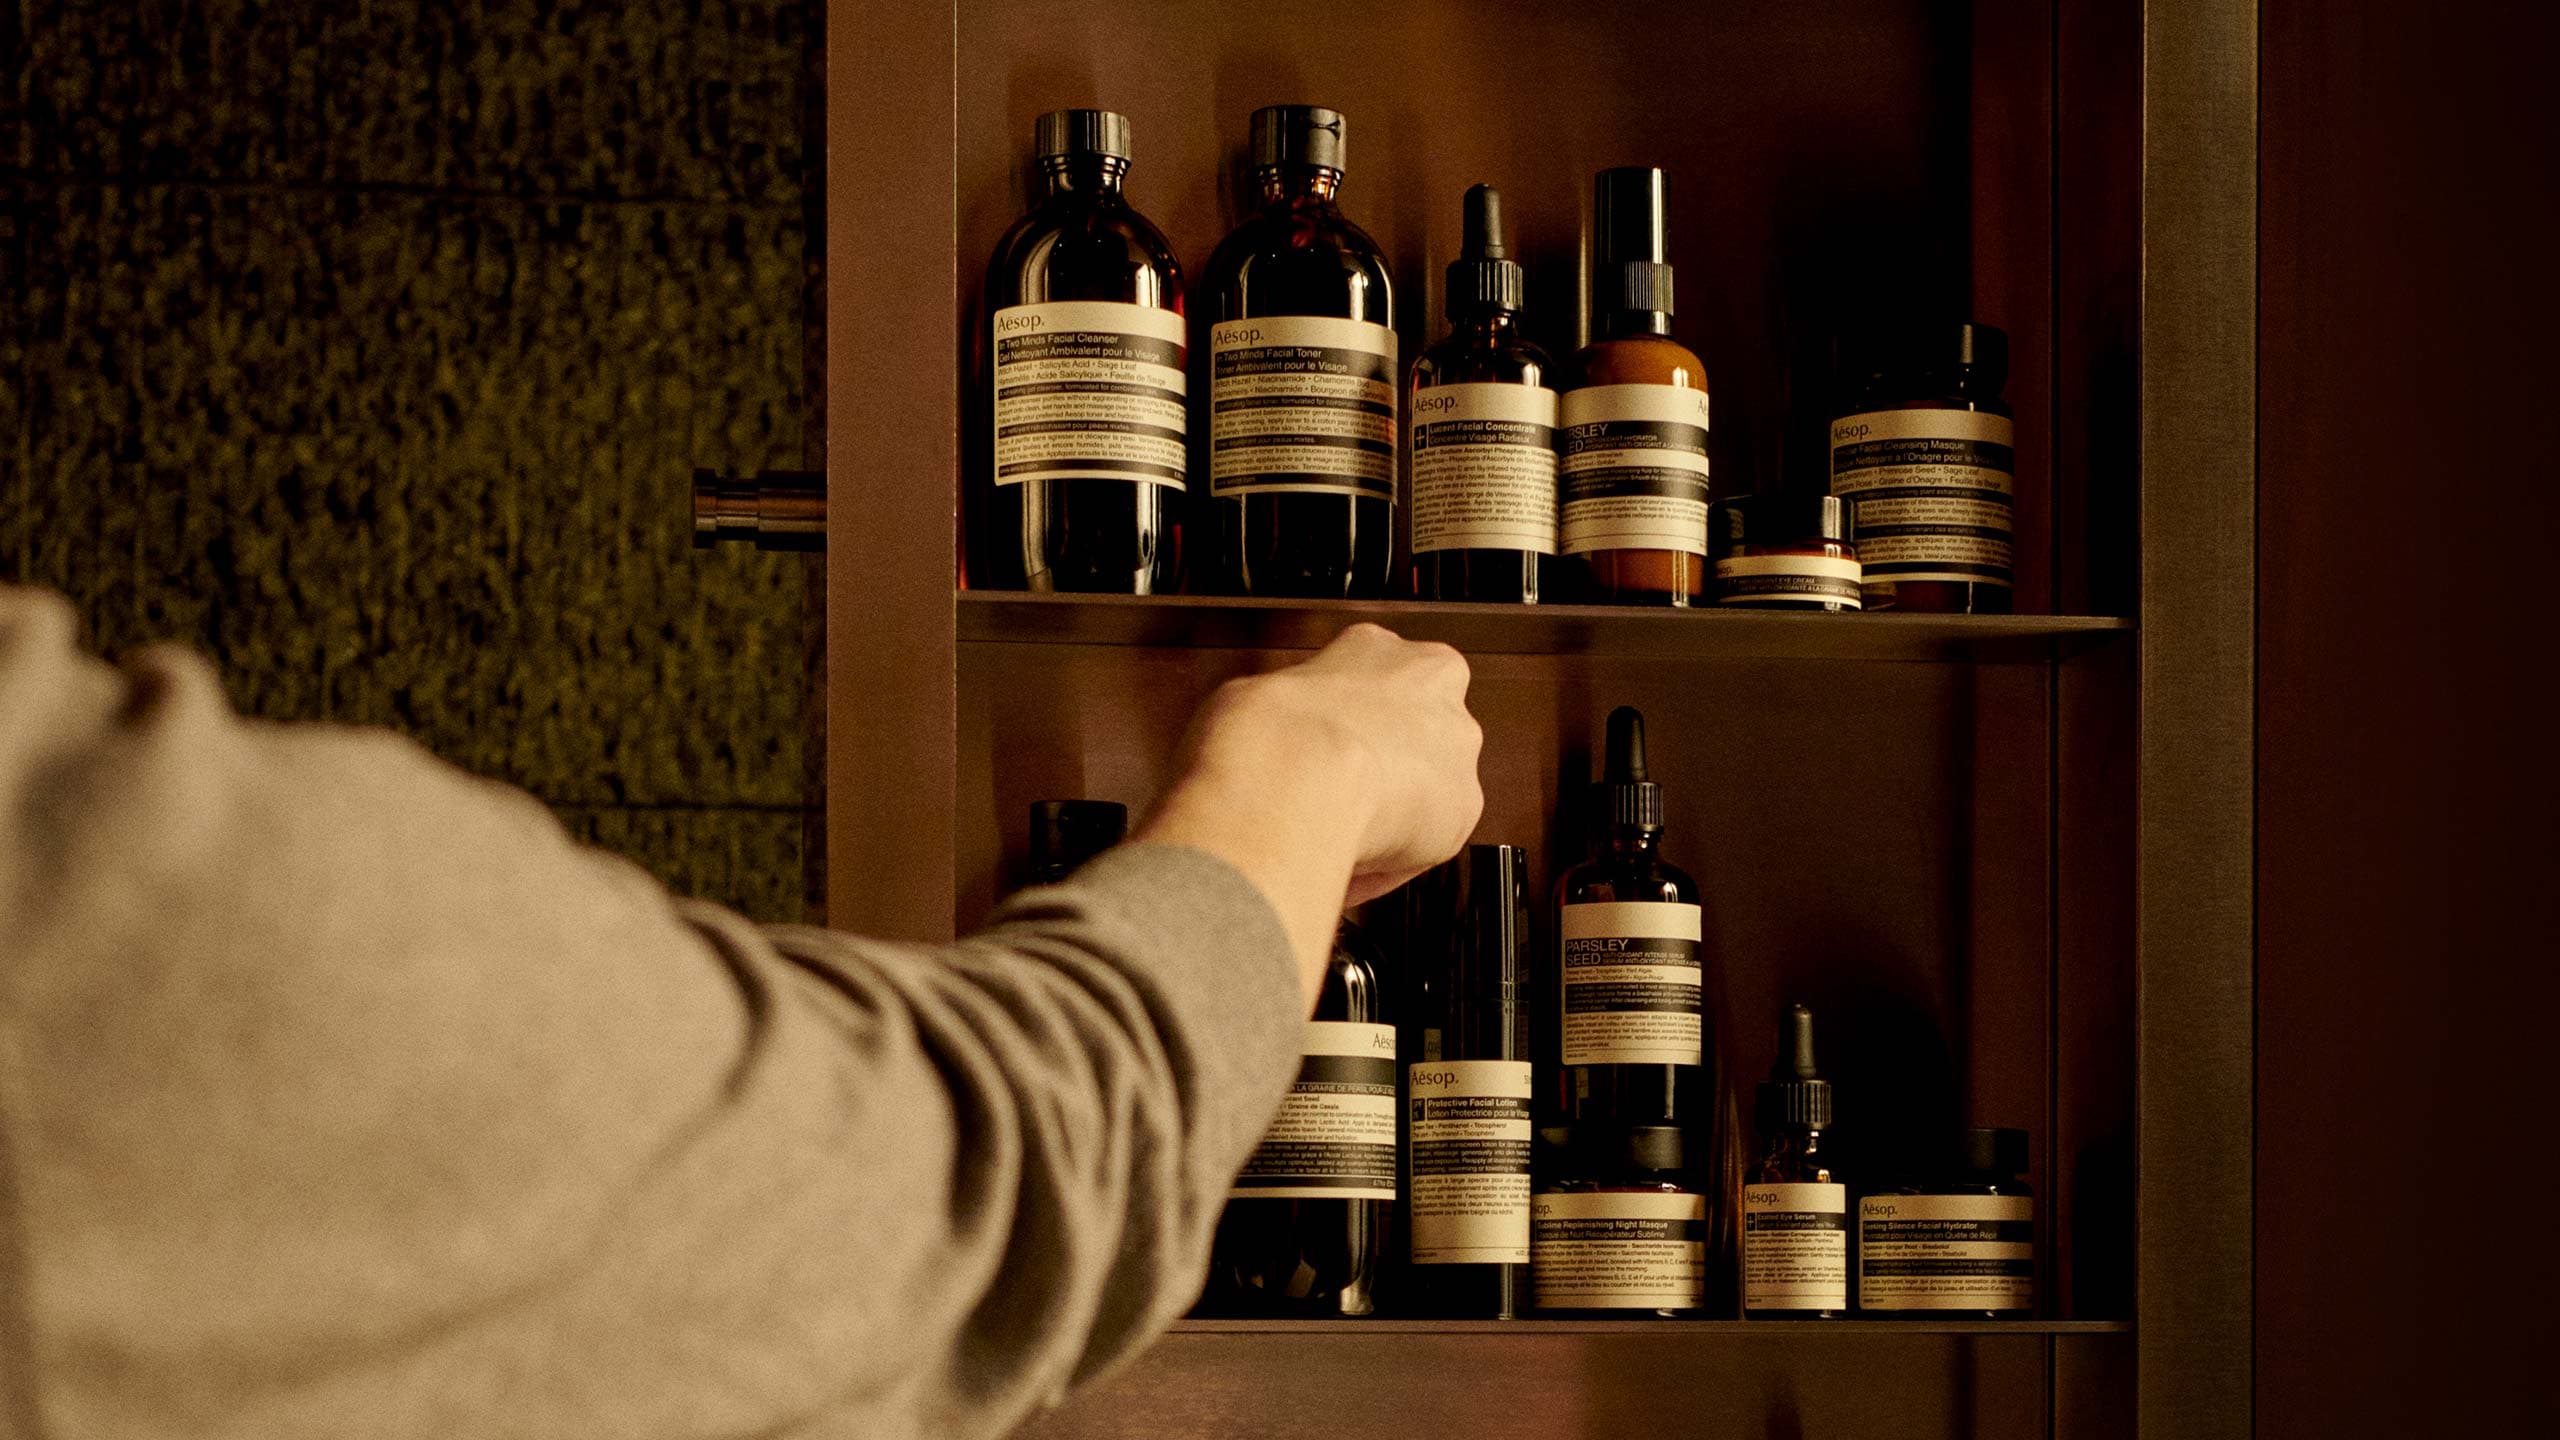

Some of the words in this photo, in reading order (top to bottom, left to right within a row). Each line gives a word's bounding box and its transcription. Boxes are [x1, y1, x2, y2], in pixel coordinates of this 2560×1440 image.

[1006, 338, 1020, 348] Two
[1021, 335, 1046, 346] Minds
[1048, 333, 1075, 344] Facial
[1077, 332, 1119, 344] Cleanser
[999, 352, 1010, 363] Gel
[1011, 348, 1048, 360] Nettoyant
[1050, 346, 1100, 357] Ambivalent
[1103, 348, 1123, 357] pour
[1125, 348, 1133, 356] le
[1135, 349, 1160, 362] Visage
[1224, 352, 1239, 361] Two
[1240, 350, 1265, 360] Minds
[1267, 348, 1294, 358] Facial
[1297, 348, 1322, 358] Toner
[1039, 360, 1070, 370] Salicylic
[1072, 359, 1090, 368] Acid
[1097, 360, 1119, 370] Sage
[1121, 362, 1136, 370] Leaf
[1236, 361, 1282, 372] Ambivalent
[1284, 361, 1304, 371] pour
[1307, 360, 1316, 369] le
[1318, 361, 1348, 373] Visage
[1036, 371, 1057, 380] Acide
[1059, 370, 1103, 381] Salicylique
[1110, 372, 1135, 381] Feuille
[1258, 375, 1306, 383] Niacinamide
[1255, 385, 1303, 393] Niacinamide
[1458, 423, 1483, 431] Facial
[1485, 422, 1537, 433] Concentrate
[1566, 424, 1608, 440] RSLEY
[1468, 433, 1497, 443] Visage
[1498, 433, 1530, 443] Radieux
[1569, 439, 1584, 454] ED
[1884, 441, 1928, 451] Cleansing
[1930, 440, 1965, 451] Masque
[1903, 452, 1942, 462] l'Onagre
[1943, 453, 1964, 463] pour
[1879, 467, 1914, 476] Primrose
[1943, 467, 1962, 475] Sage
[1879, 476, 1905, 485] Graine
[1907, 475, 1942, 484] d'Onagre
[1566, 939, 1629, 953] PARSLEY
[1566, 953, 1601, 967] SEED
[1428, 1099, 1468, 1107] Protective
[1469, 1098, 1494, 1107] Facial
[1495, 1098, 1518, 1107] Lotion
[1428, 1109, 1449, 1118] Lotion
[1450, 1109, 1493, 1118] Protectrice
[1494, 1110, 1510, 1119] pour
[1563, 1221, 1613, 1230] Replenishing
[1616, 1221, 1637, 1230] Night
[1639, 1221, 1668, 1230] Masque
[1888, 1222, 1915, 1230] Silence
[1917, 1222, 1941, 1230] Facial
[1943, 1222, 1978, 1231] Hydrator
[1586, 1230, 1635, 1239] Récupérateur
[1637, 1230, 1665, 1239] Sublime
[1908, 1231, 1932, 1241] Visage
[1945, 1231, 1968, 1239] Quête
[1969, 1231, 1979, 1239] de
[1980, 1231, 1997, 1240] Répit
